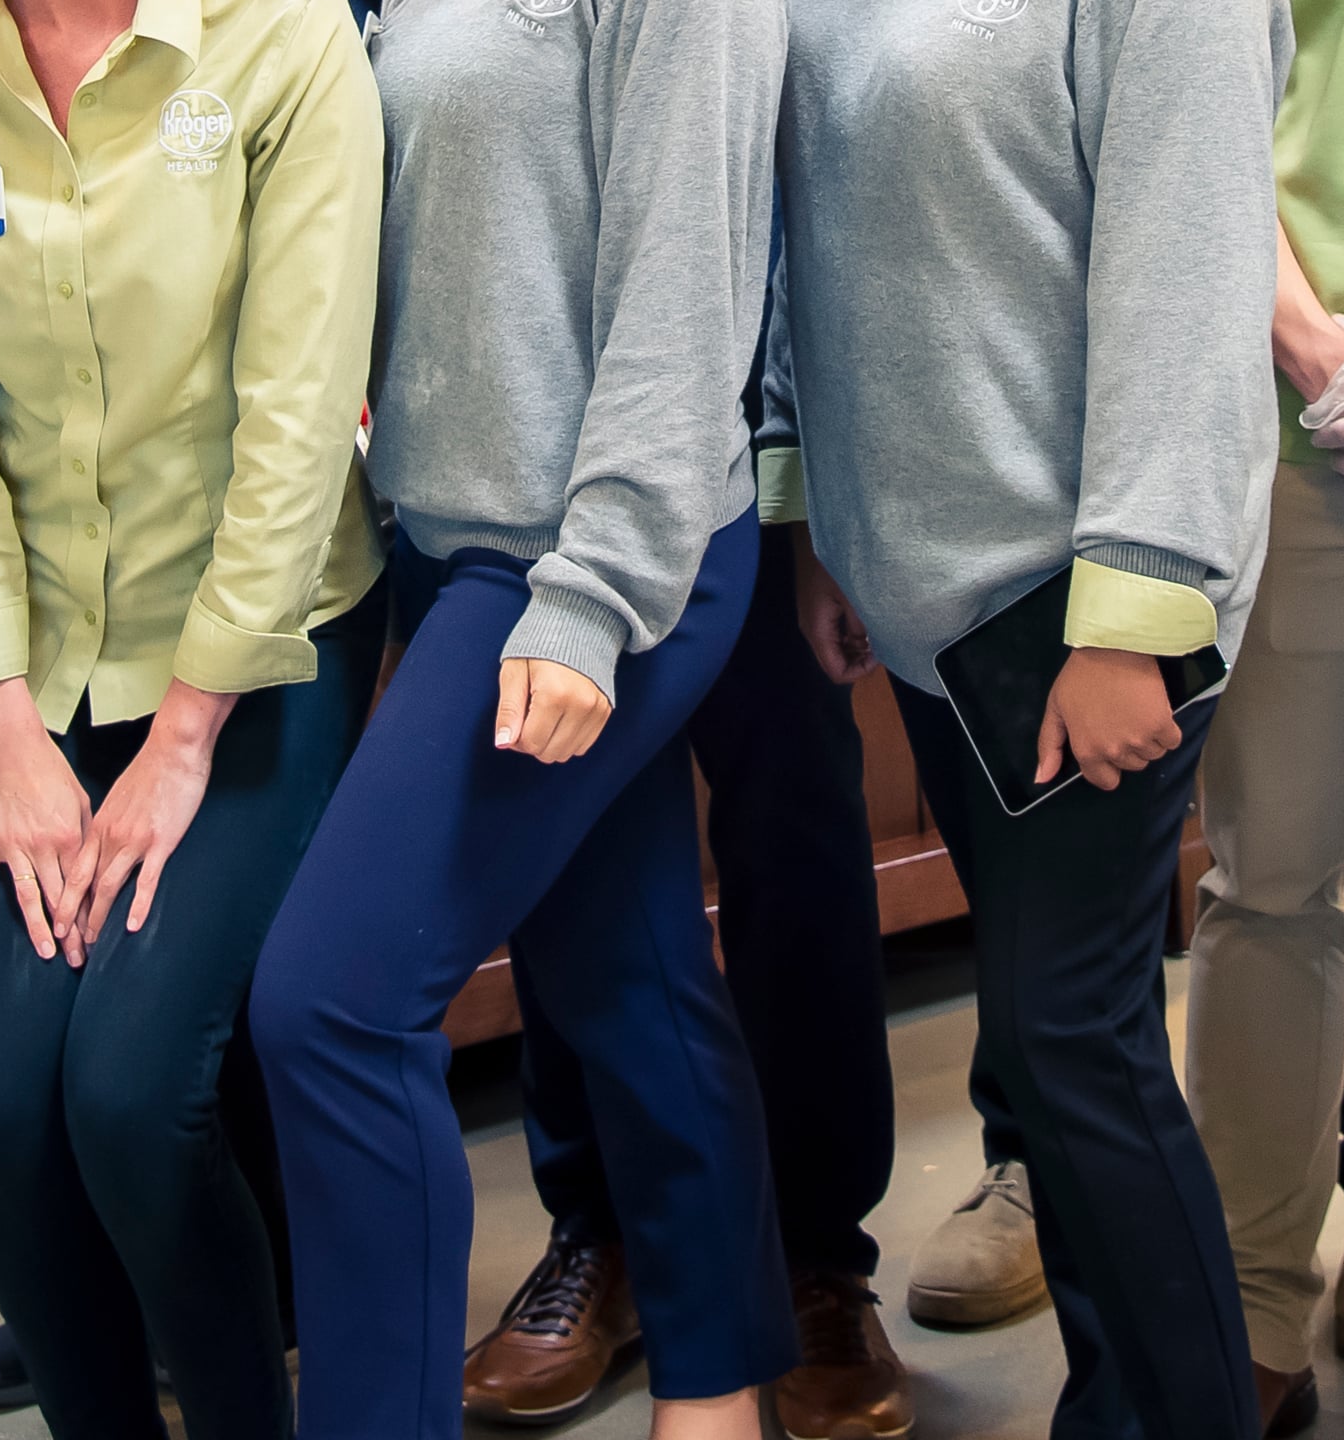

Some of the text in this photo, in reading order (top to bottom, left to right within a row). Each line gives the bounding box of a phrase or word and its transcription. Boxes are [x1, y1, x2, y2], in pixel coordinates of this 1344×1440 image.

[506, 9, 546, 35] HEALTH
[951, 18, 995, 42] HEALTH
[164, 100, 227, 149] Kroger
[167, 160, 217, 171] HEALTH
